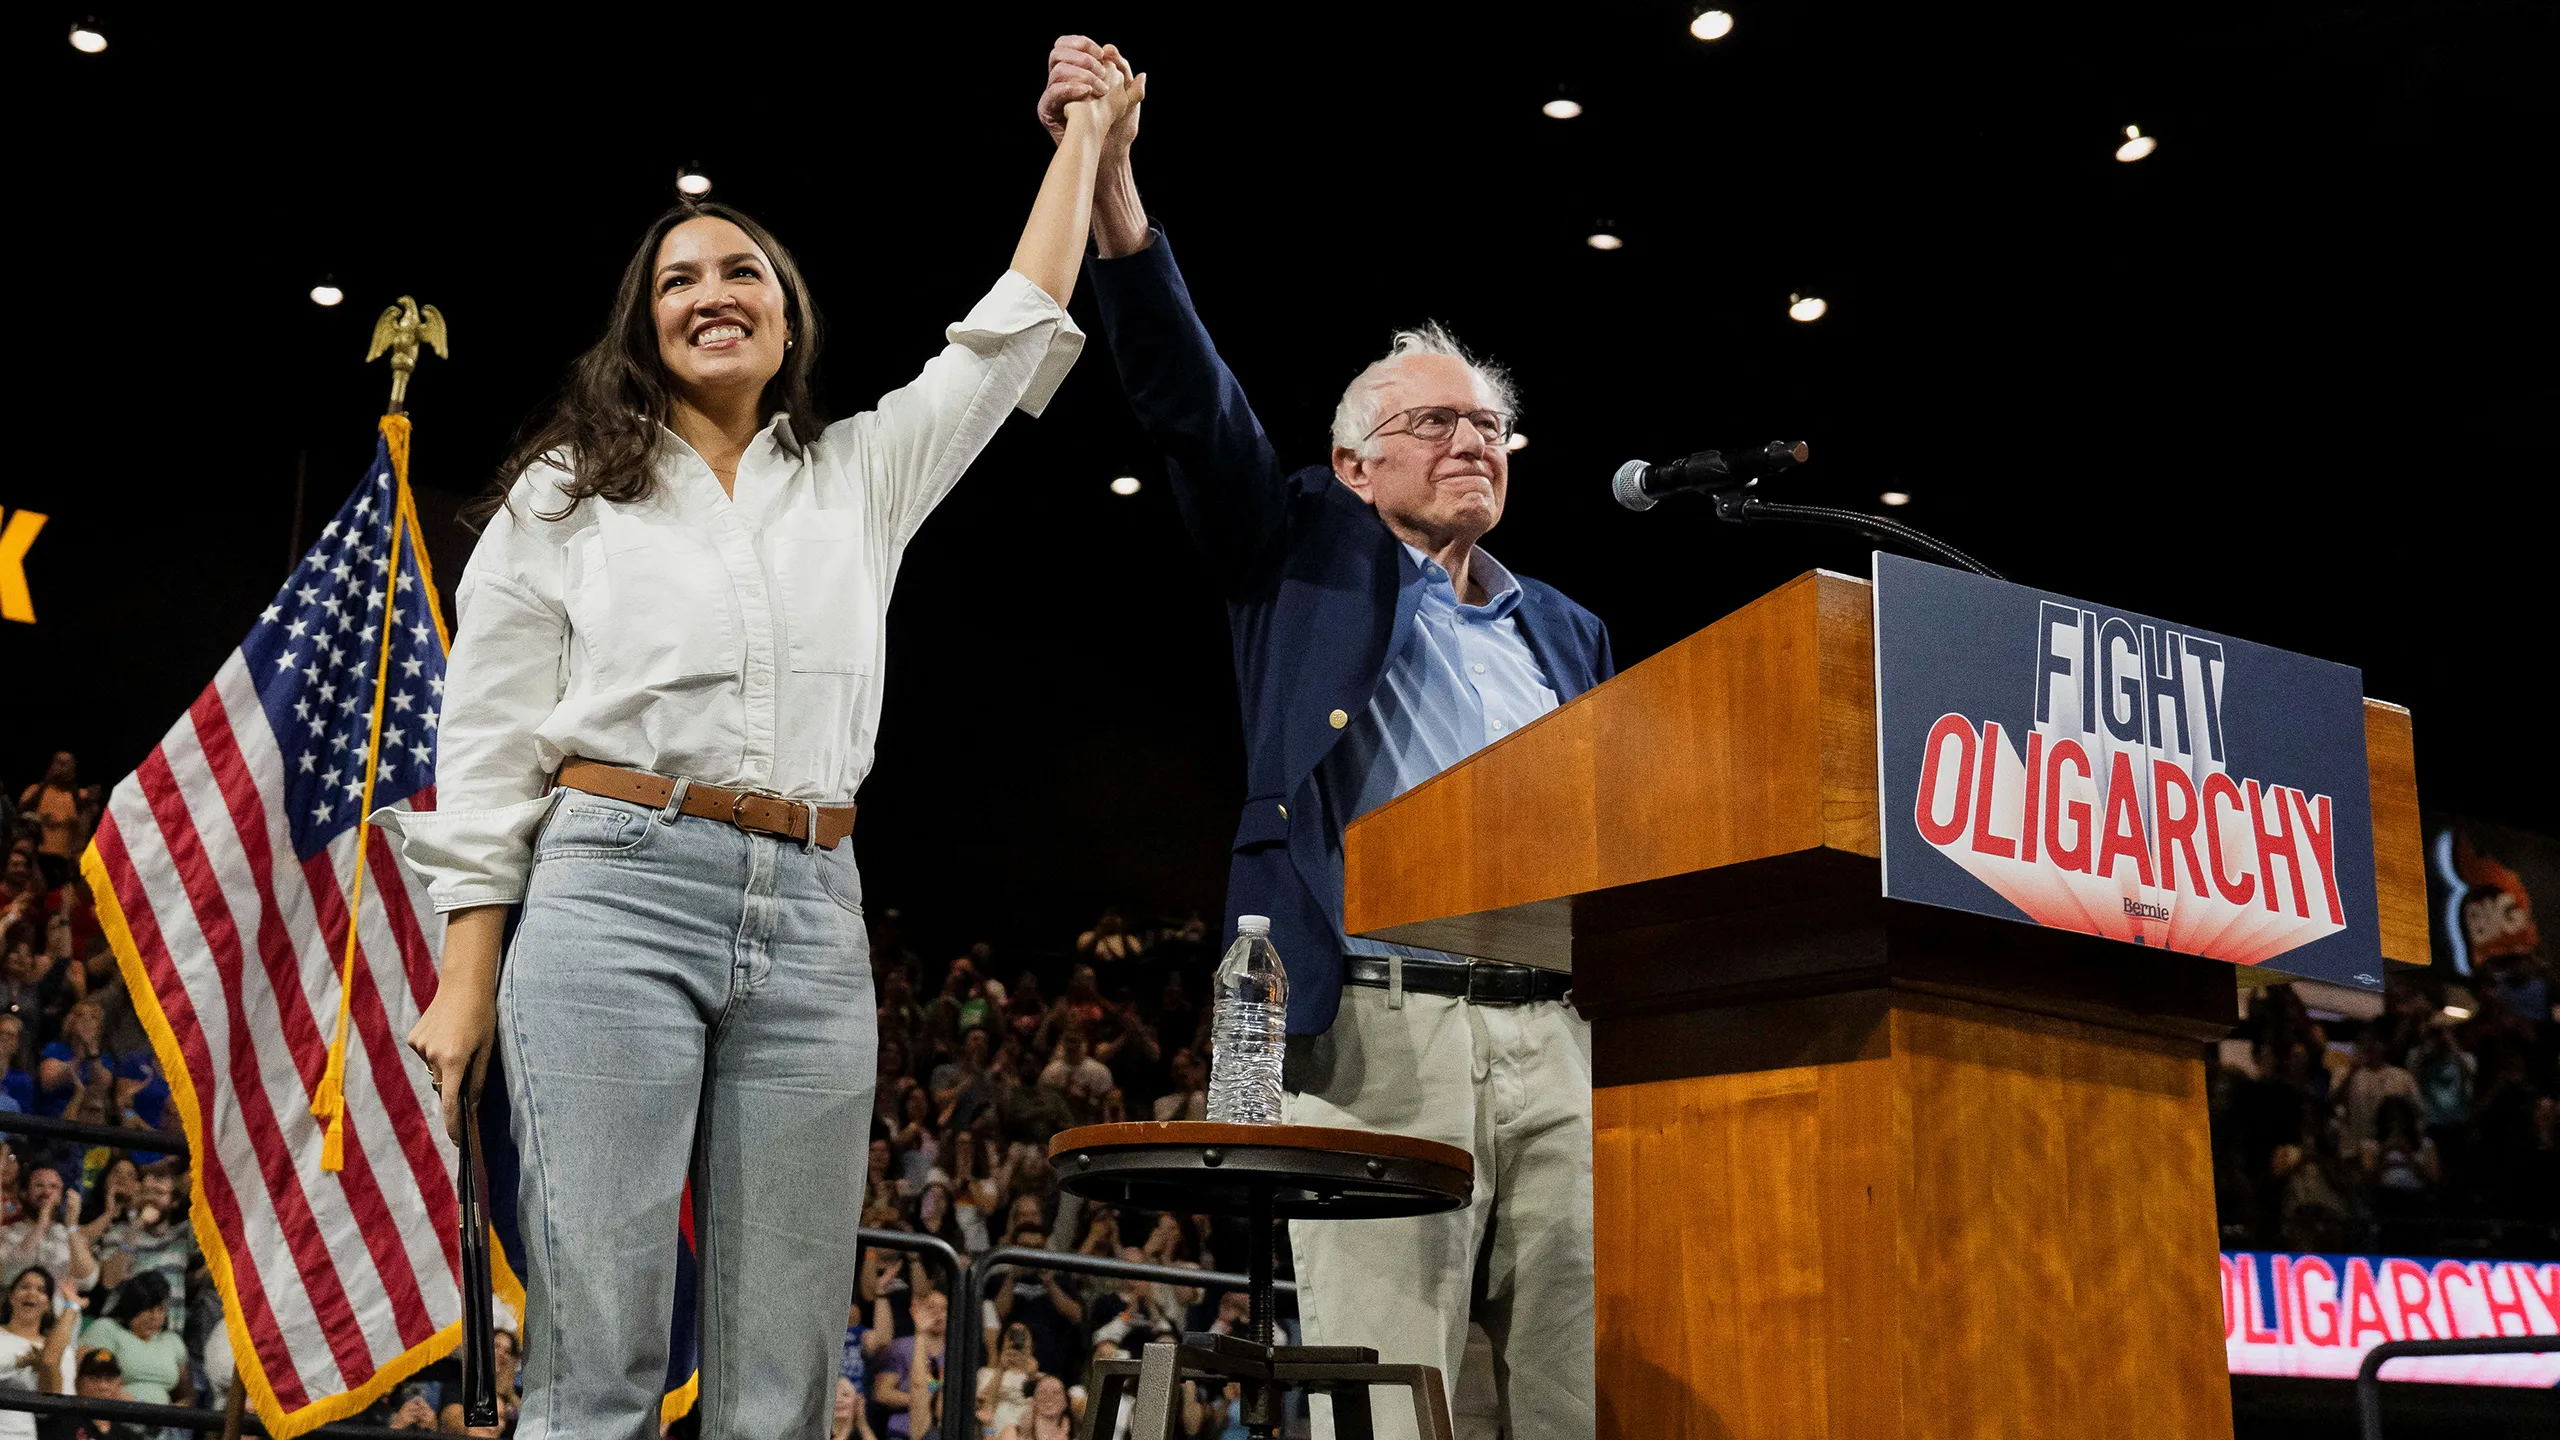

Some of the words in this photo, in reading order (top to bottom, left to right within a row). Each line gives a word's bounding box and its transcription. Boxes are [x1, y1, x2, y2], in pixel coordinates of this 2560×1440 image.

[2034, 600, 2226, 764] FIGHT
[1914, 712, 2346, 927] OLIGARCHY
[2123, 897, 2169, 921] Bernie
